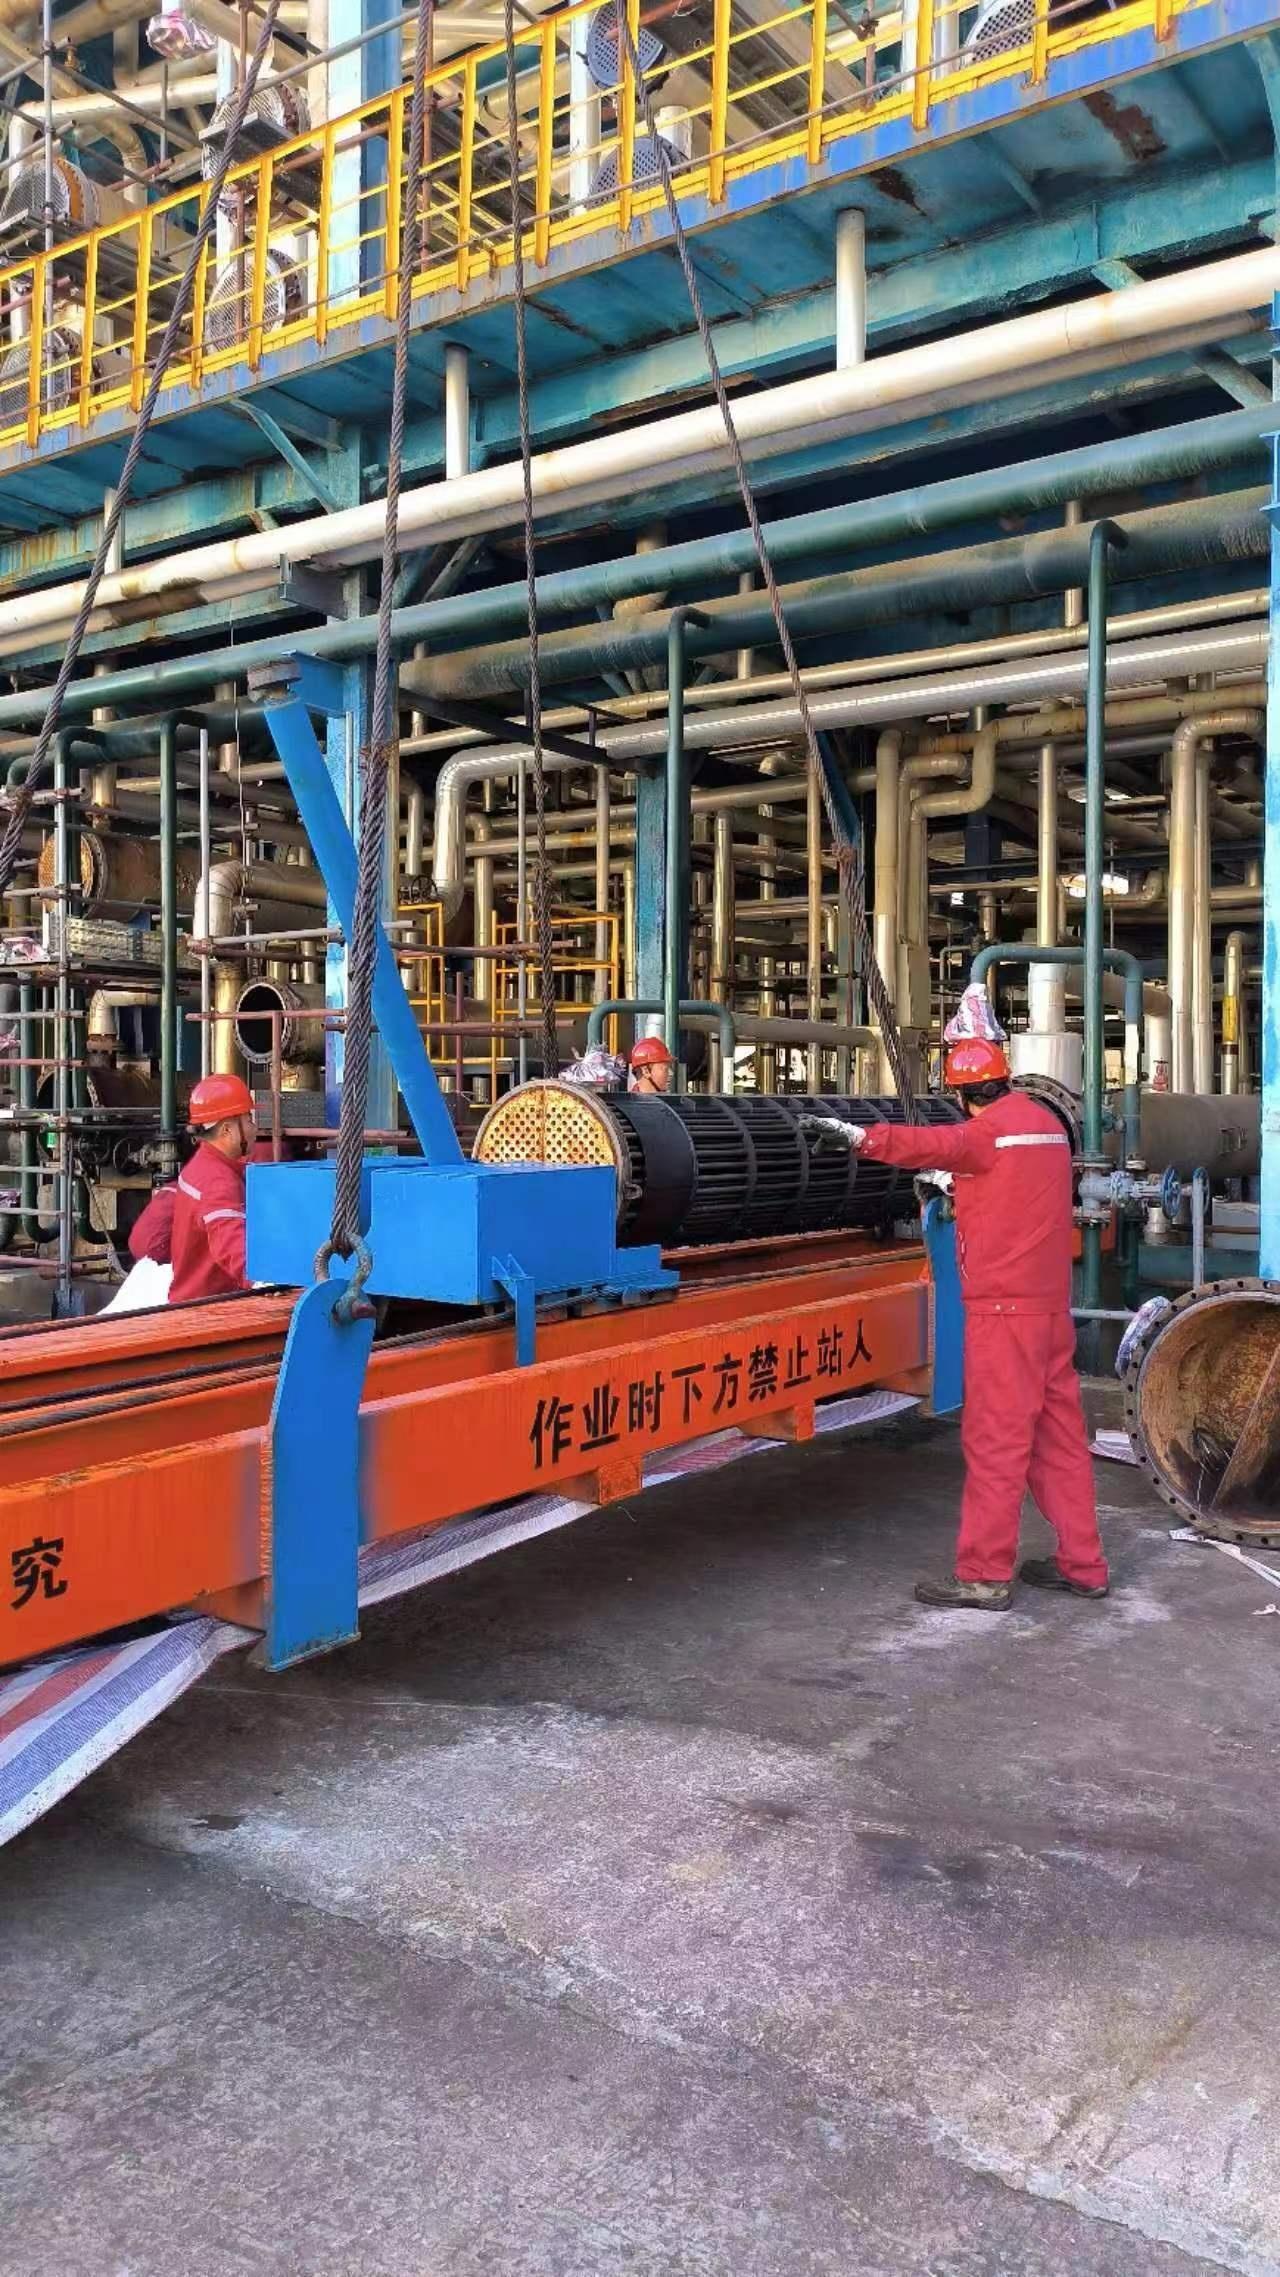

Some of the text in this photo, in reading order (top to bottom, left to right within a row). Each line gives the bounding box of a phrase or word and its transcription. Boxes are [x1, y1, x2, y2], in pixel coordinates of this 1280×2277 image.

[529, 1319, 873, 1470] 作业时下方禁止站人
[10, 1536, 68, 1610] 究
